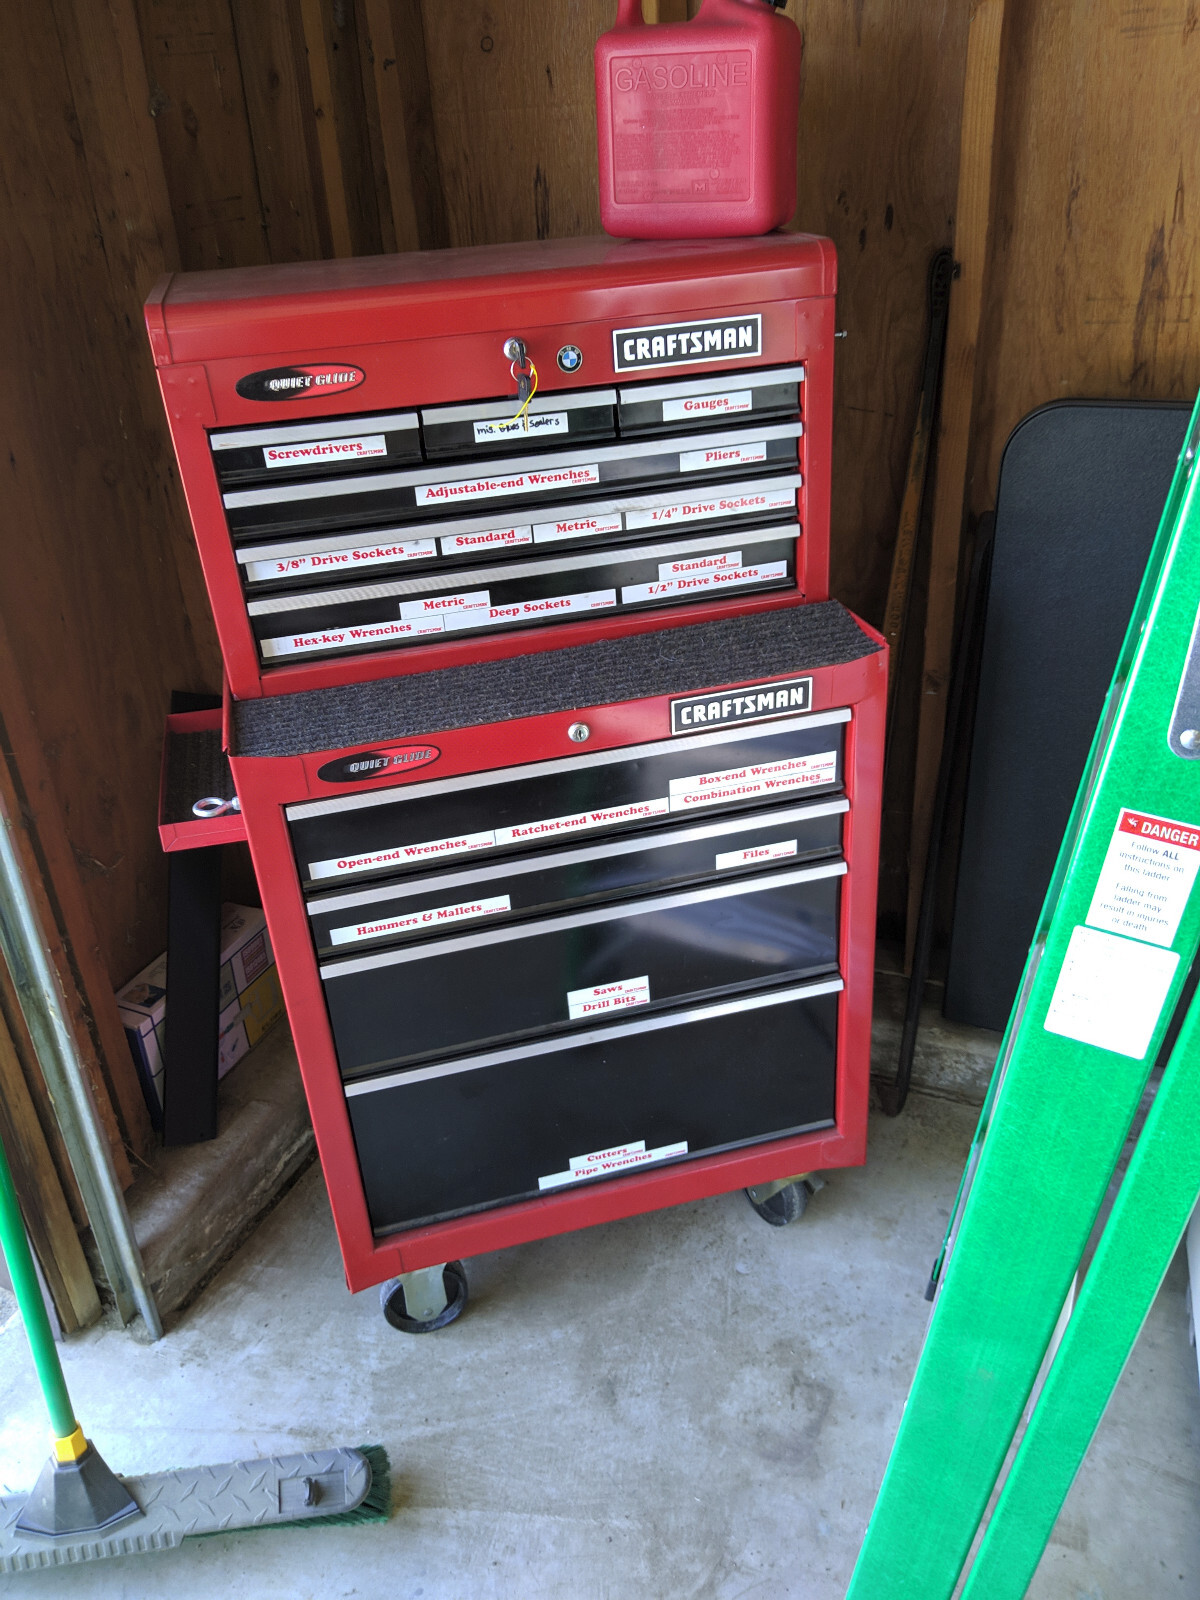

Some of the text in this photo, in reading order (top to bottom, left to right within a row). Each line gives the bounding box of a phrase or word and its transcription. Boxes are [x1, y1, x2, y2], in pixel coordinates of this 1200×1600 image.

[616, 62, 747, 92] GASOLINE
[623, 325, 753, 361] CRAFTSMAN
[269, 371, 356, 391] QUIET GLIDE
[684, 398, 729, 411] Gauges
[268, 442, 363, 460] Screwdrivers
[705, 450, 741, 462] Pliers
[425, 469, 590, 498] Adjustable-end Wrenches
[682, 503, 715, 515] Drive
[719, 495, 766, 510] Sockets
[556, 519, 597, 533] Metric
[456, 530, 515, 546] Standard
[311, 554, 348, 567] Drive
[352, 545, 404, 560] Sockets
[672, 556, 727, 572] Standard
[677, 577, 709, 589] Drive
[713, 568, 758, 583] Sockets
[423, 597, 465, 611] Metric
[489, 598, 571, 618] Deep Sockets
[293, 622, 412, 648] Hex-key Wrenches
[681, 687, 803, 725] CRAFTSMAN
[349, 749, 432, 773] QUIET GLIDE
[698, 760, 807, 786] Box-end Wrenches
[684, 772, 821, 804] Combination Wrenches
[512, 805, 650, 838] Ratchet-end Wrenches
[1141, 821, 1200, 847] DANGER
[337, 839, 467, 870] Open-end Wrenches
[742, 848, 769, 860] Files
[1119, 851, 1171, 870] instructions
[1131, 841, 1180, 861] Follow ALL
[1124, 863, 1140, 875] this
[1148, 891, 1168, 902] from
[1100, 902, 1125, 914] result
[1144, 903, 1162, 914] may
[356, 904, 482, 936] Hammers & Mallets
[593, 984, 623, 996] Saws
[583, 995, 636, 1013] Drill Bits
[587, 1147, 628, 1162] Cutters
[575, 1153, 652, 1177] Pipe Wrenches
